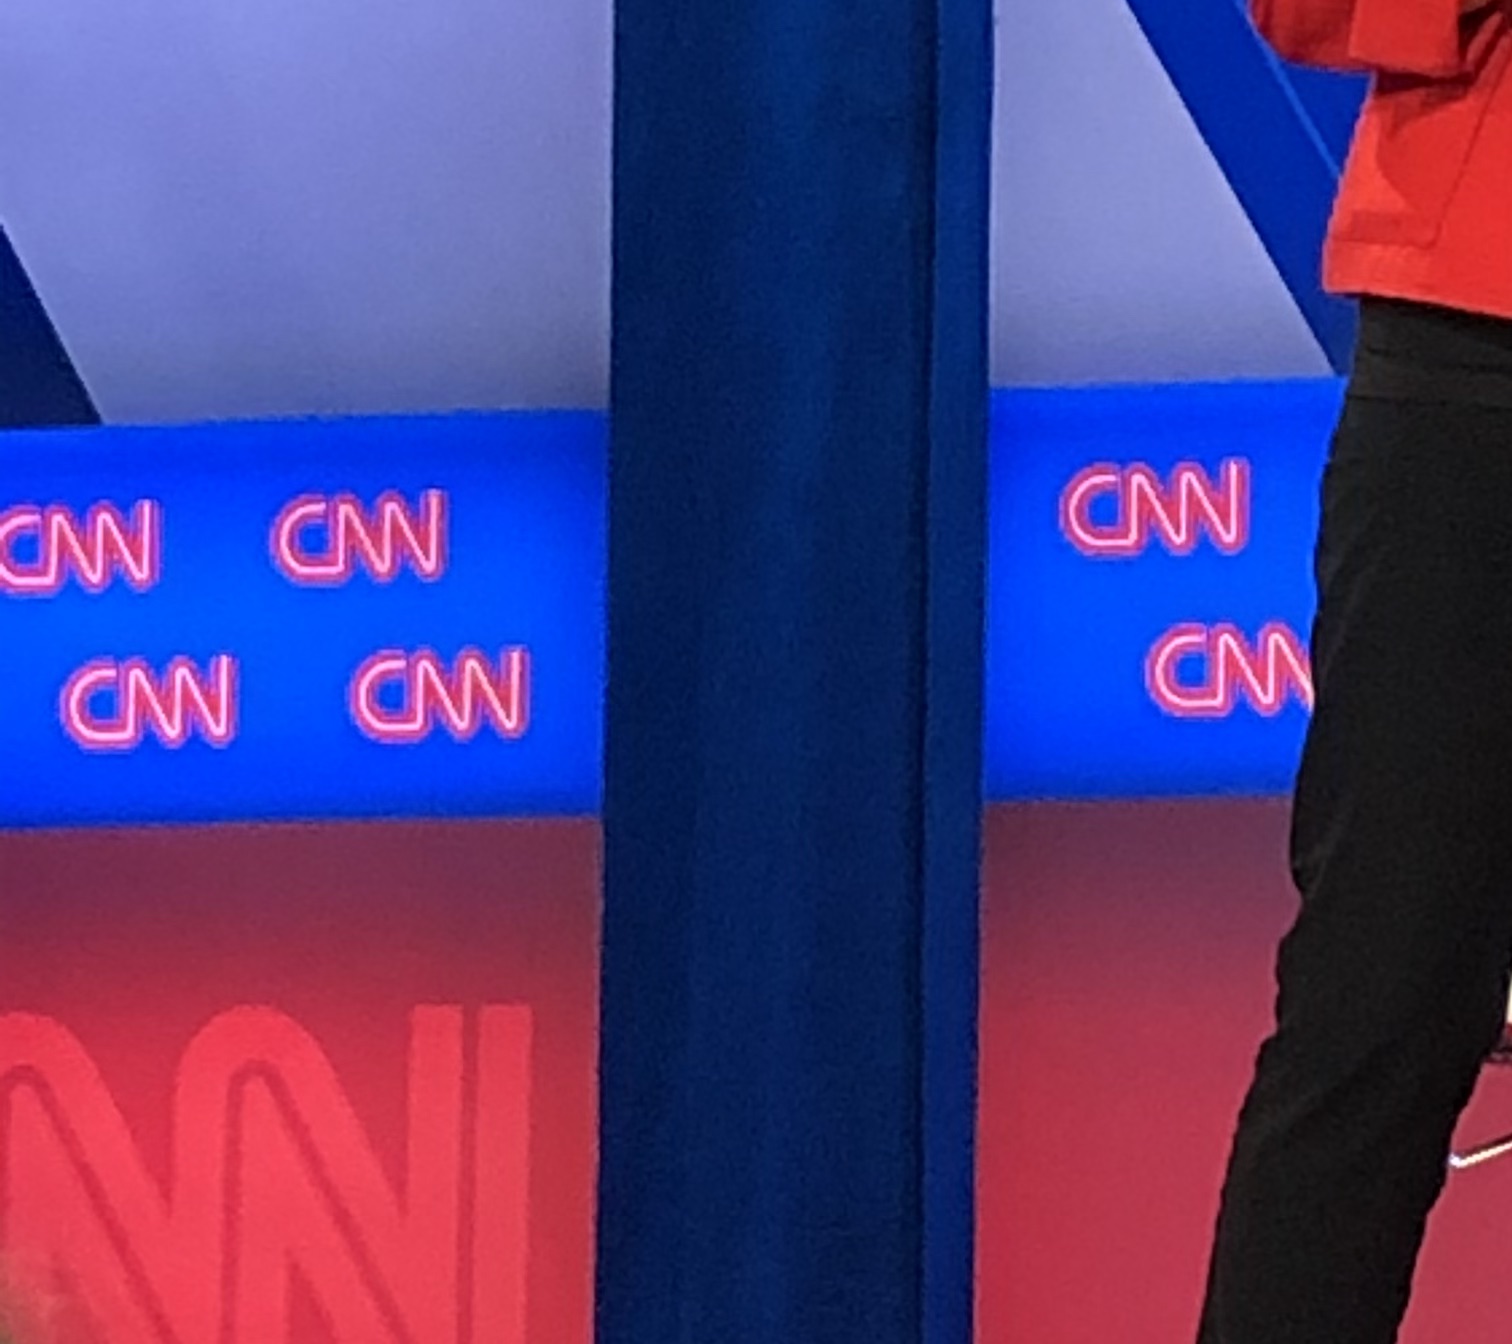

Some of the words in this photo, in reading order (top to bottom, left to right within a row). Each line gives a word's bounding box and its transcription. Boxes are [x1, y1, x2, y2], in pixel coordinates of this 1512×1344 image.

[0, 497, 160, 597] CNN
[269, 486, 449, 585] CNN
[1058, 456, 1251, 559] CNN
[58, 651, 239, 752] CNN
[347, 642, 528, 744] CNN
